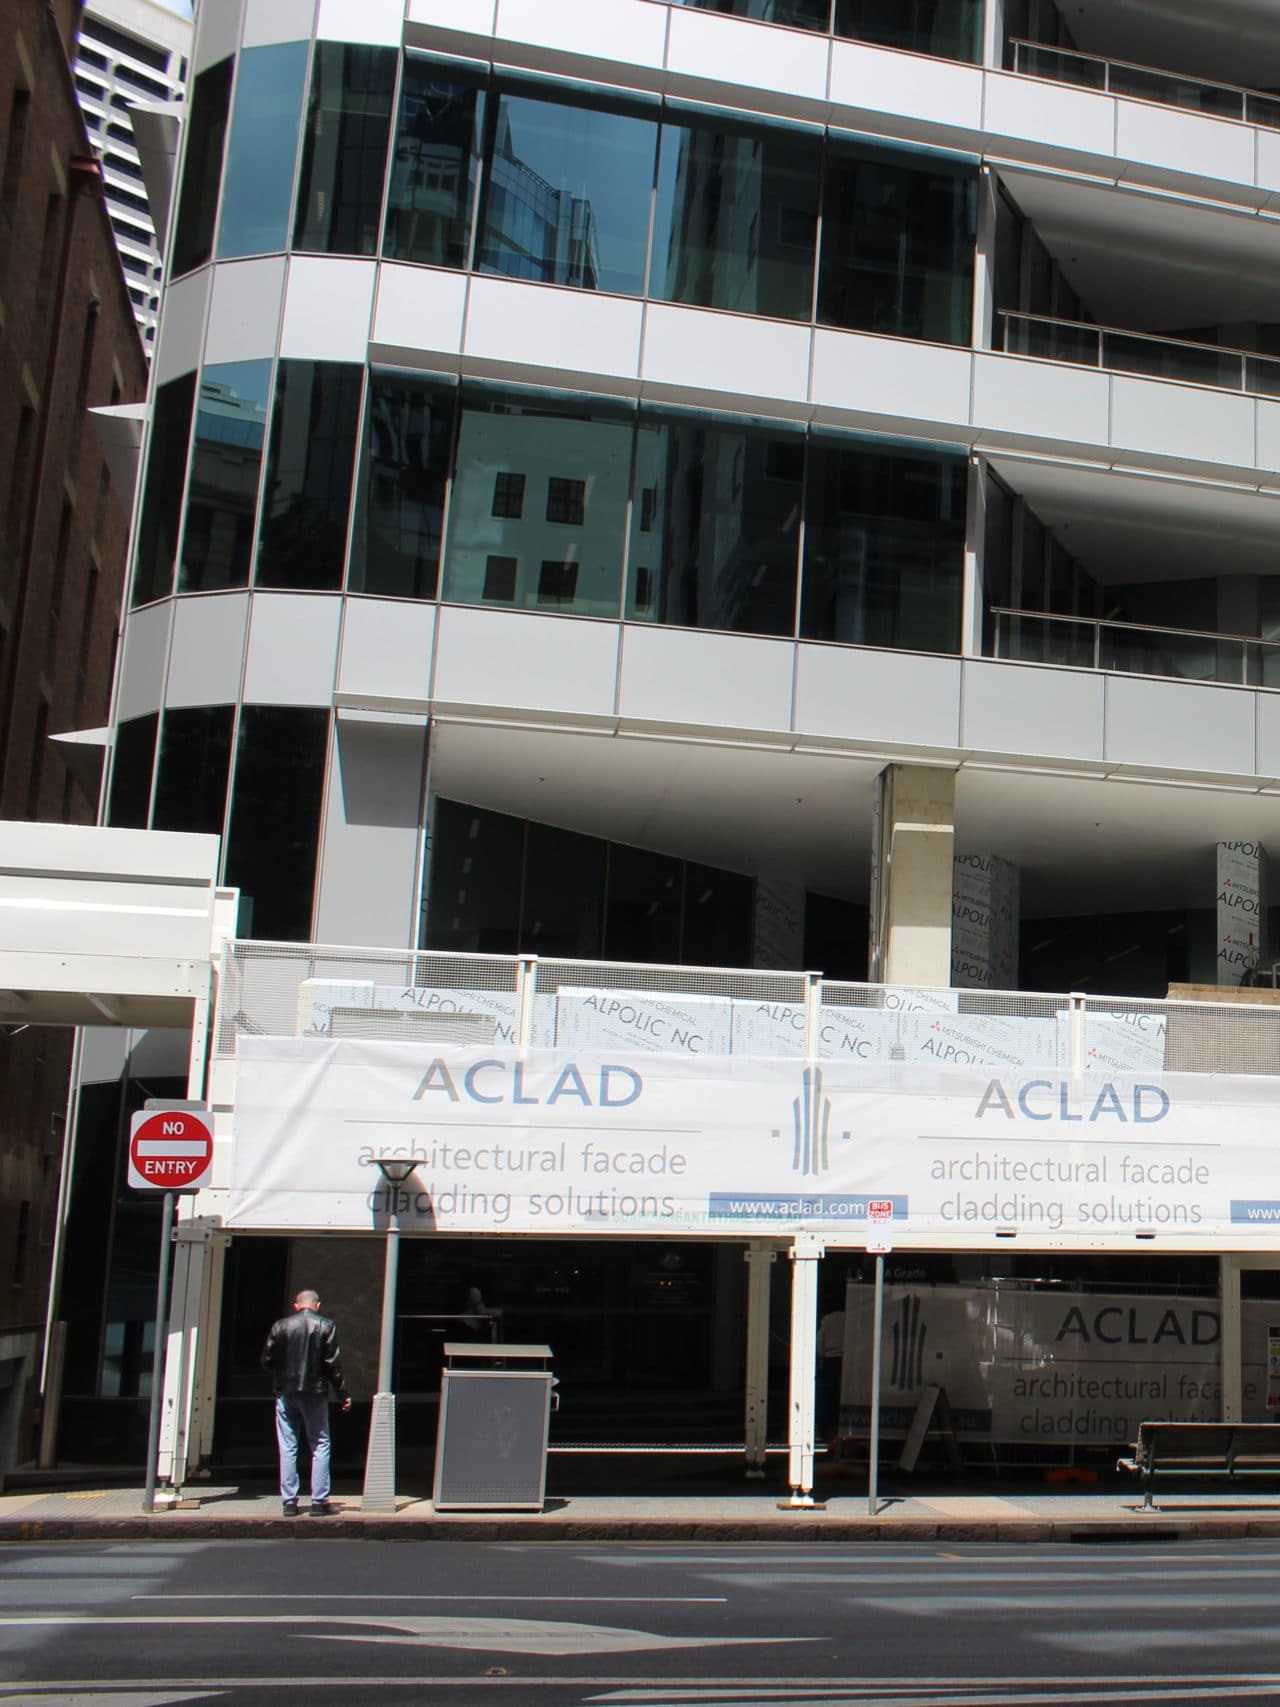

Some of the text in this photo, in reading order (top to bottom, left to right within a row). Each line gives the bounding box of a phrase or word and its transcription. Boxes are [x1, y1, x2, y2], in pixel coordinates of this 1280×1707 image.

[583, 995, 667, 1037] ALPOLIC
[671, 1028, 704, 1053] NC
[840, 1033, 872, 1058] NC
[412, 1058, 643, 1107] ACLAD
[974, 1079, 1170, 1123] ACLAD
[162, 1121, 185, 1135] NO
[144, 1160, 197, 1175] ENTRY
[580, 1142, 687, 1175] facade
[930, 1151, 1210, 1185] architectural facade
[366, 1183, 676, 1224] cladding solutions
[729, 1198, 864, 1217] www.aclad.com
[872, 1202, 890, 1210] BUS
[940, 1193, 1201, 1229] cladding solutions
[1055, 1306, 1221, 1346] ACLAD
[1013, 1373, 1257, 1400] architectural facae
[1020, 1407, 1130, 1439] cladding
